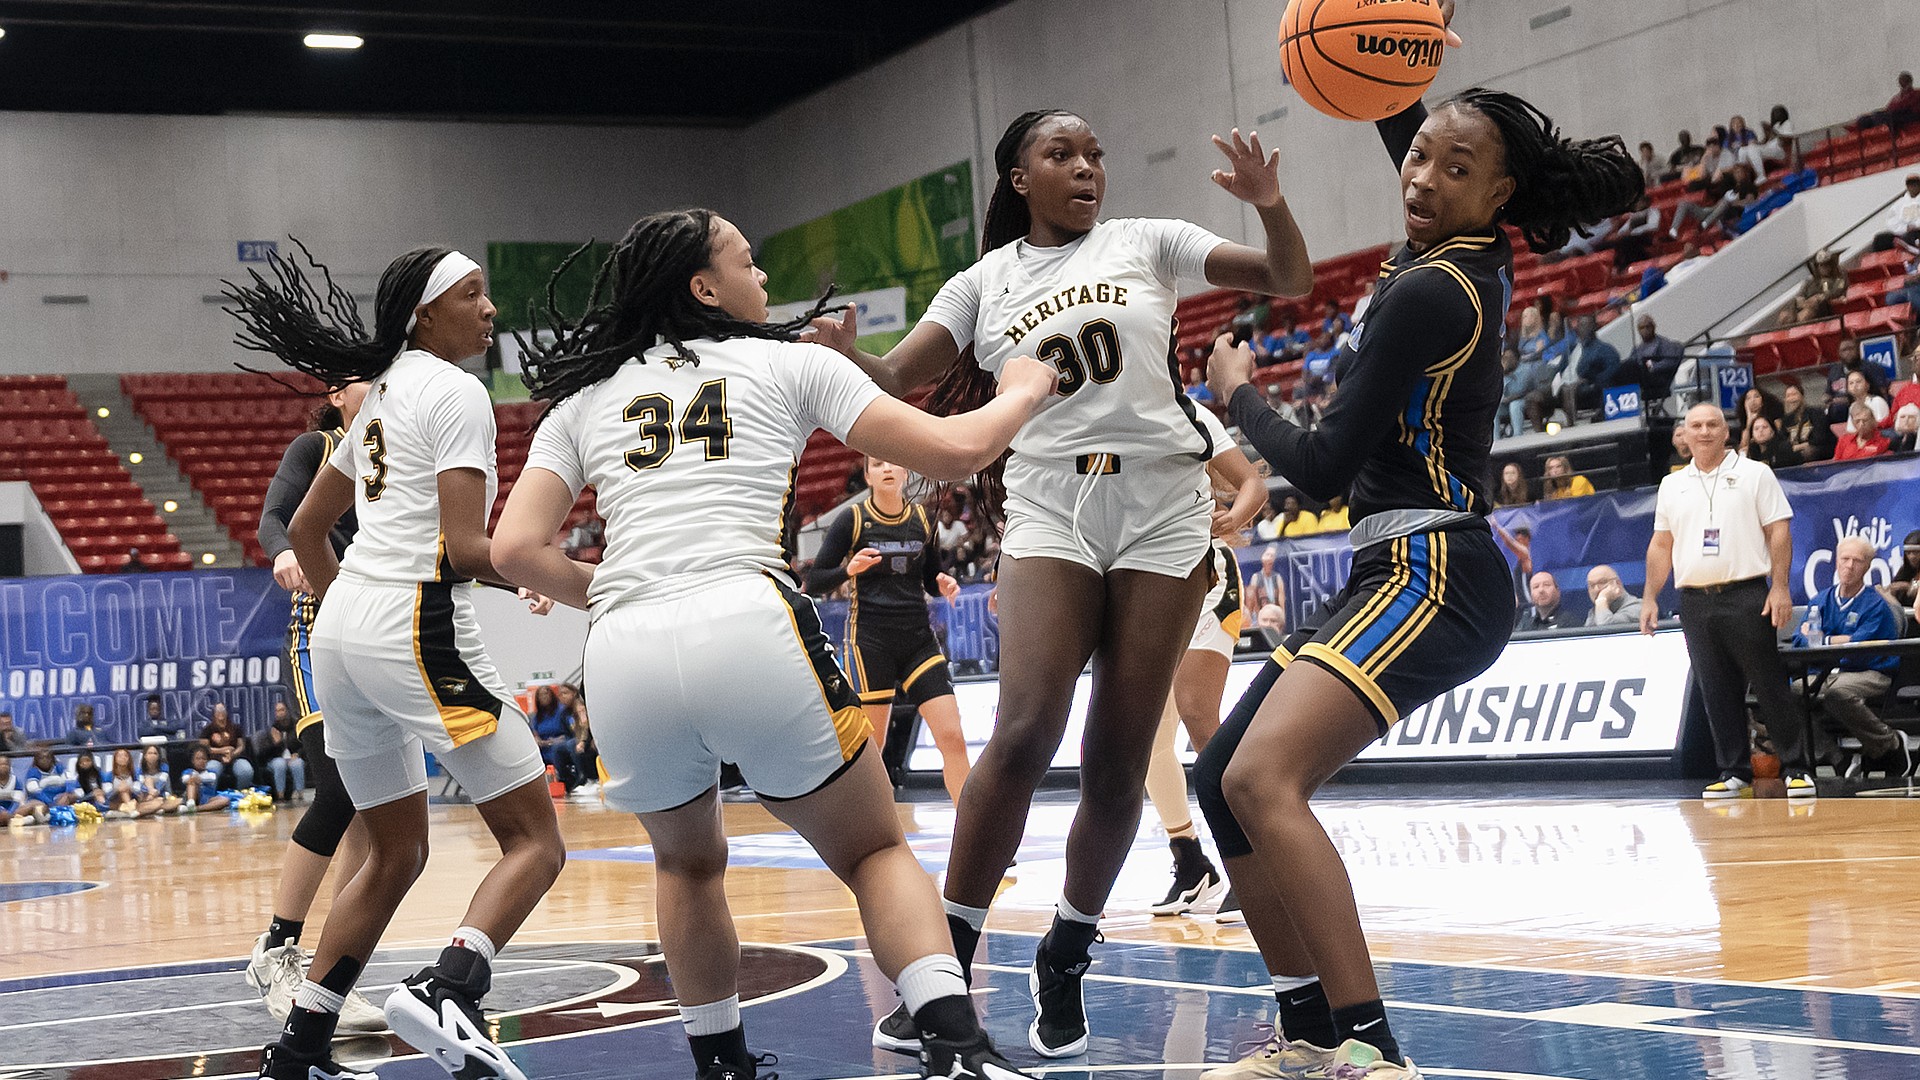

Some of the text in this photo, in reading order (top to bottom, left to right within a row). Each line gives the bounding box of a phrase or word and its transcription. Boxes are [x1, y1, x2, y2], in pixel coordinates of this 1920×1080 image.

[1356, 34, 1444, 68] Wilson
[1004, 283, 1128, 346] HERITAGE
[1036, 318, 1123, 397] 30
[1719, 367, 1748, 386] 123
[623, 378, 733, 472] 34
[362, 418, 388, 502] 3
[1804, 545, 1904, 600] Cnt
[3, 576, 240, 669] LCOME
[111, 662, 178, 692] HIGH
[1380, 677, 1646, 746] ONSHIPS
